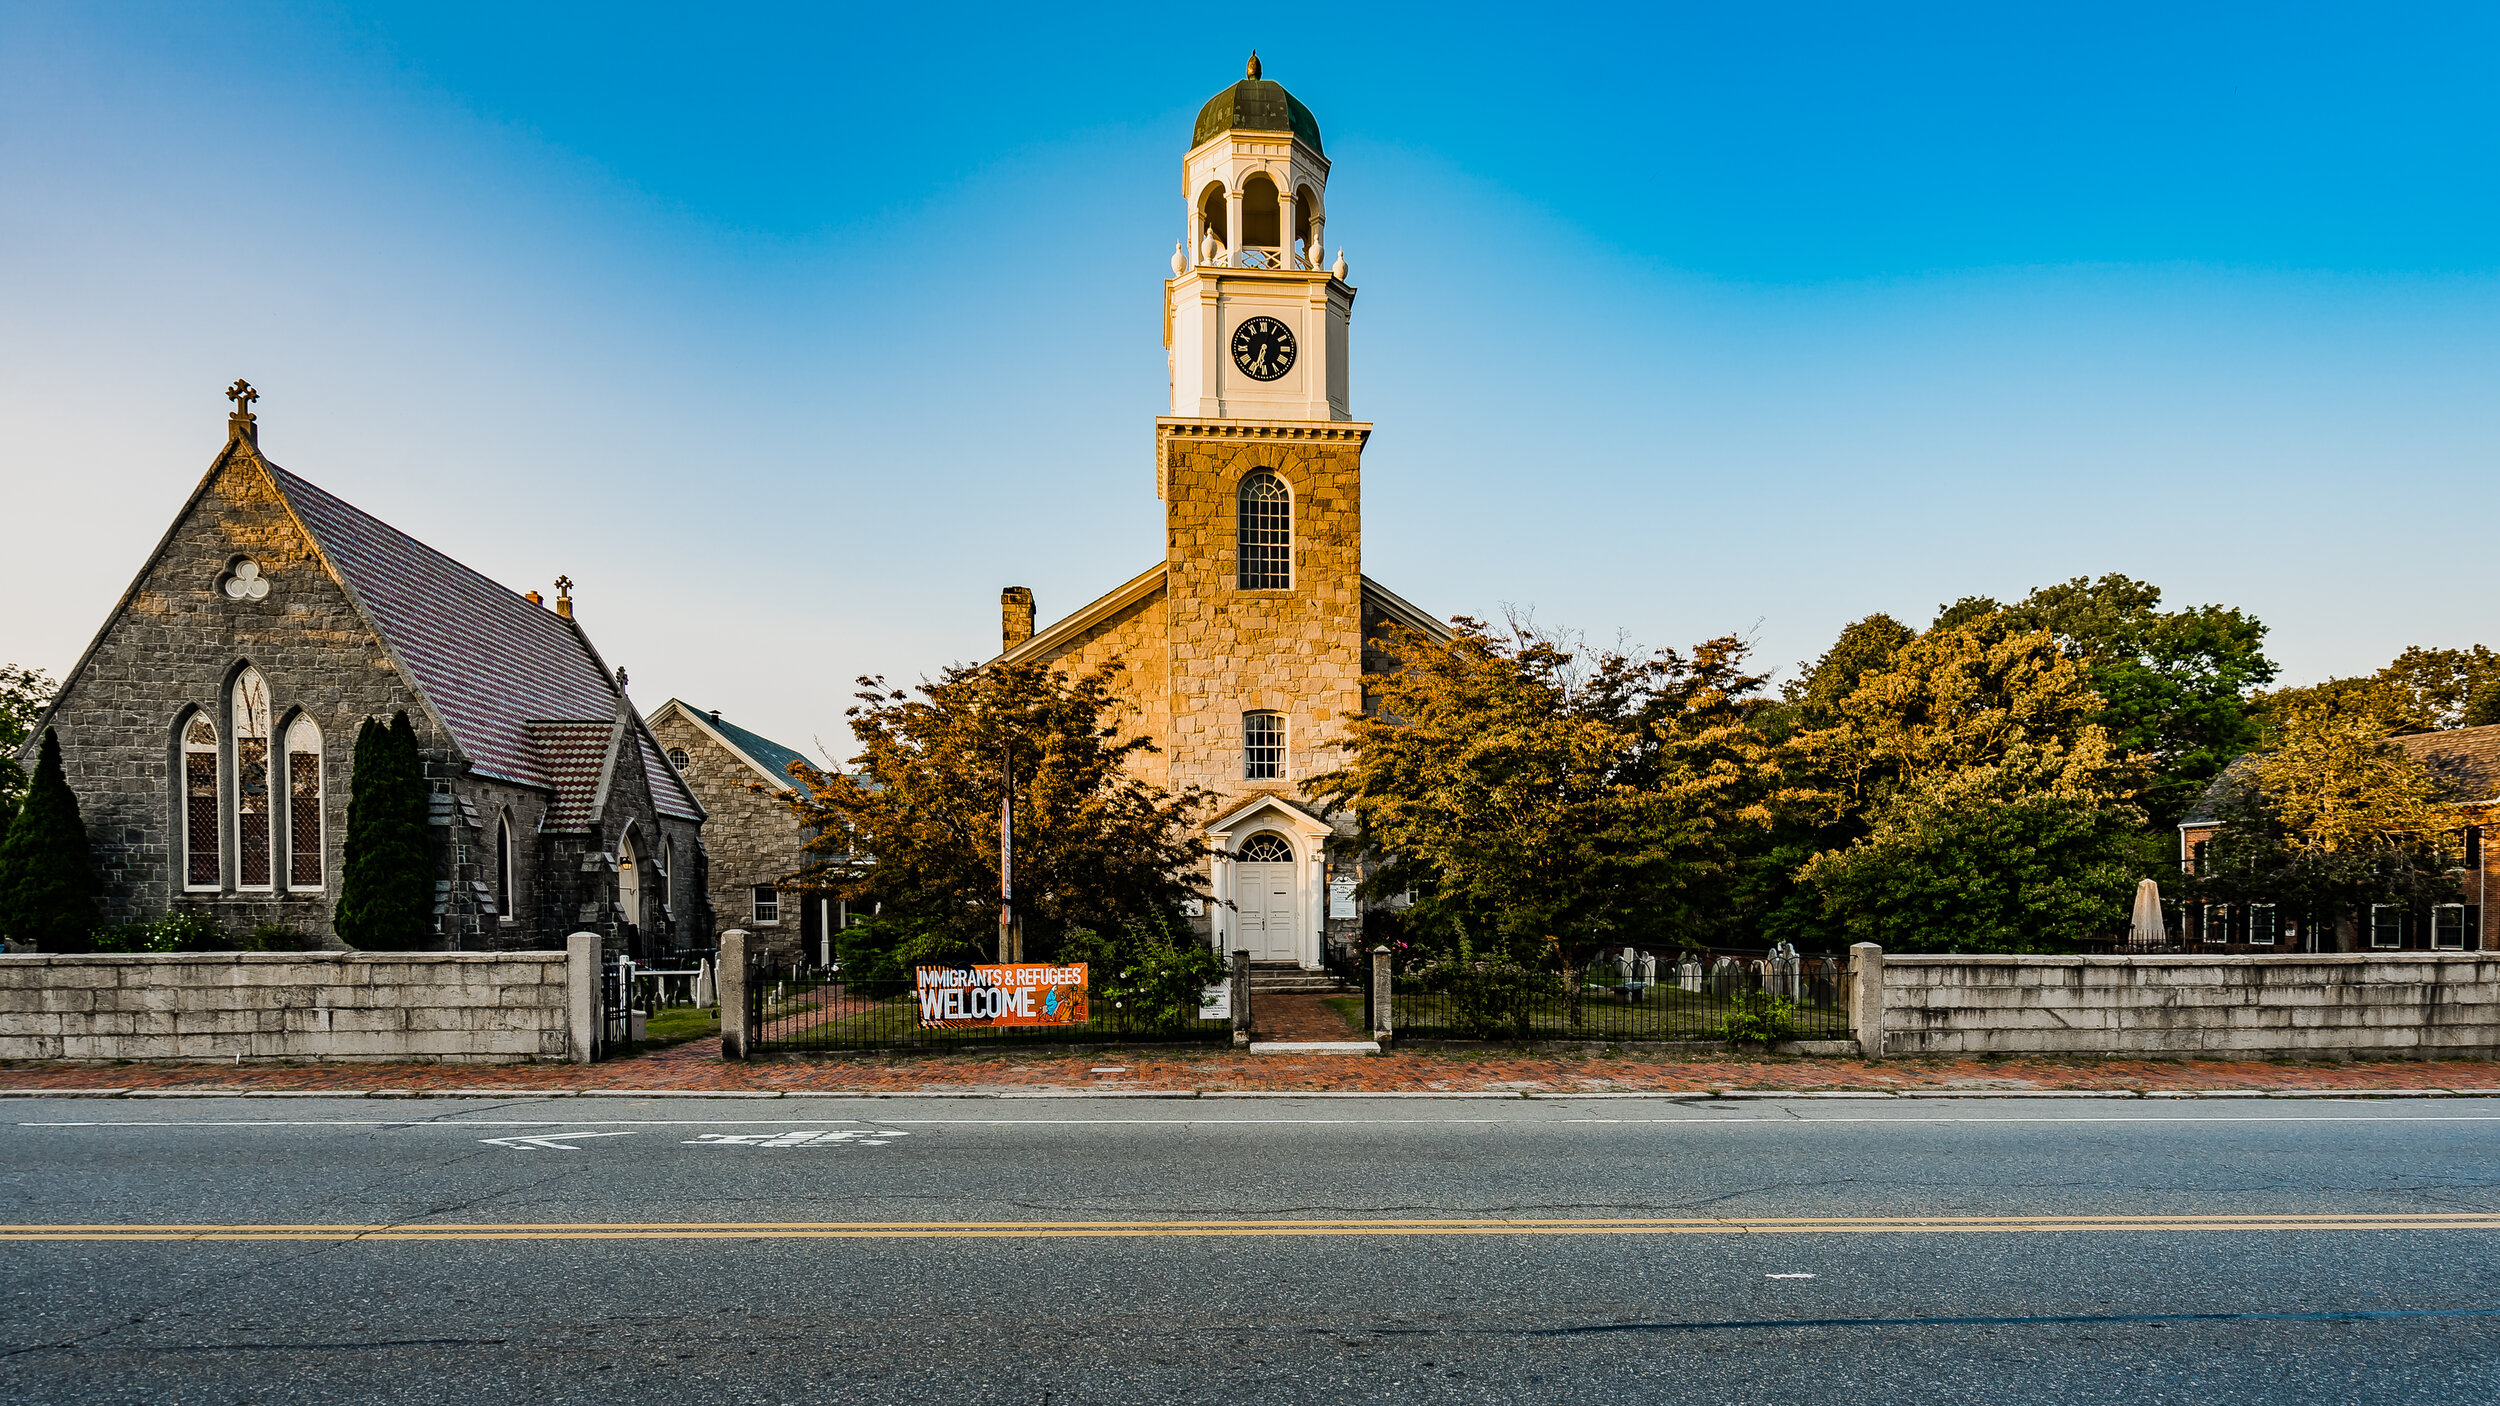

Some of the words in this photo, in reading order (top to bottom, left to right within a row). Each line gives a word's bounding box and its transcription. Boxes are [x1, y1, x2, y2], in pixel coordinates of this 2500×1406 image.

[1240, 334, 1250, 342] X
[919, 968, 1002, 987] IMMIGRANTS
[1004, 969, 1015, 986] &
[1016, 967, 1082, 986] REFUGEES
[920, 987, 1037, 1020] WELCOME
